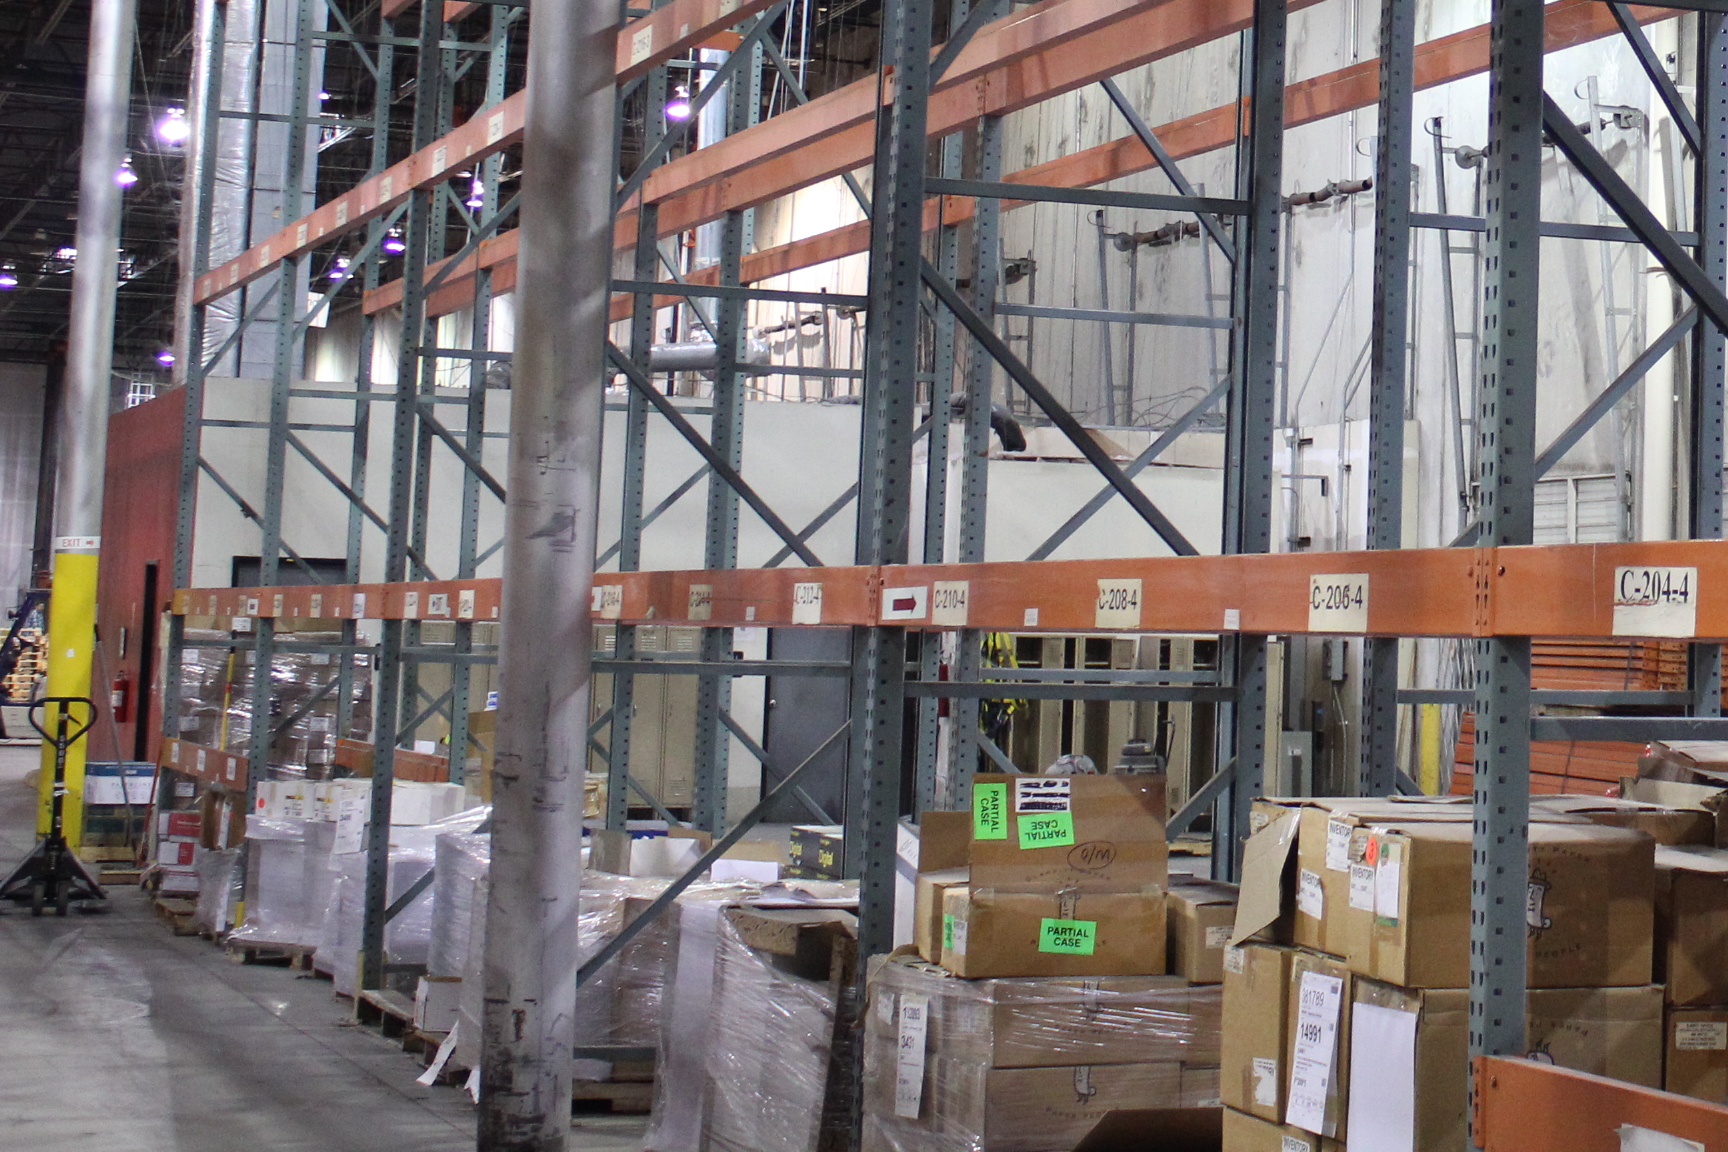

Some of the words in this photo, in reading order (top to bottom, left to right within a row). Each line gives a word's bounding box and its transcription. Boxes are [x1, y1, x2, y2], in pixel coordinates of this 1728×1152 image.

[62, 538, 81, 547] EXIT
[1620, 569, 1690, 604] C-204-4
[934, 589, 966, 609] C-210-4
[1098, 588, 1138, 610] C-208-4
[1312, 584, 1363, 610] C-206-4
[980, 798, 989, 826] CASE
[990, 790, 999, 834] PARTIAL
[1025, 828, 1067, 841] PARTIAL
[1031, 819, 1058, 831] CASE
[1047, 926, 1089, 938] PARTIAL
[1053, 937, 1081, 947] CASE
[1300, 1022, 1322, 1043] 14991
